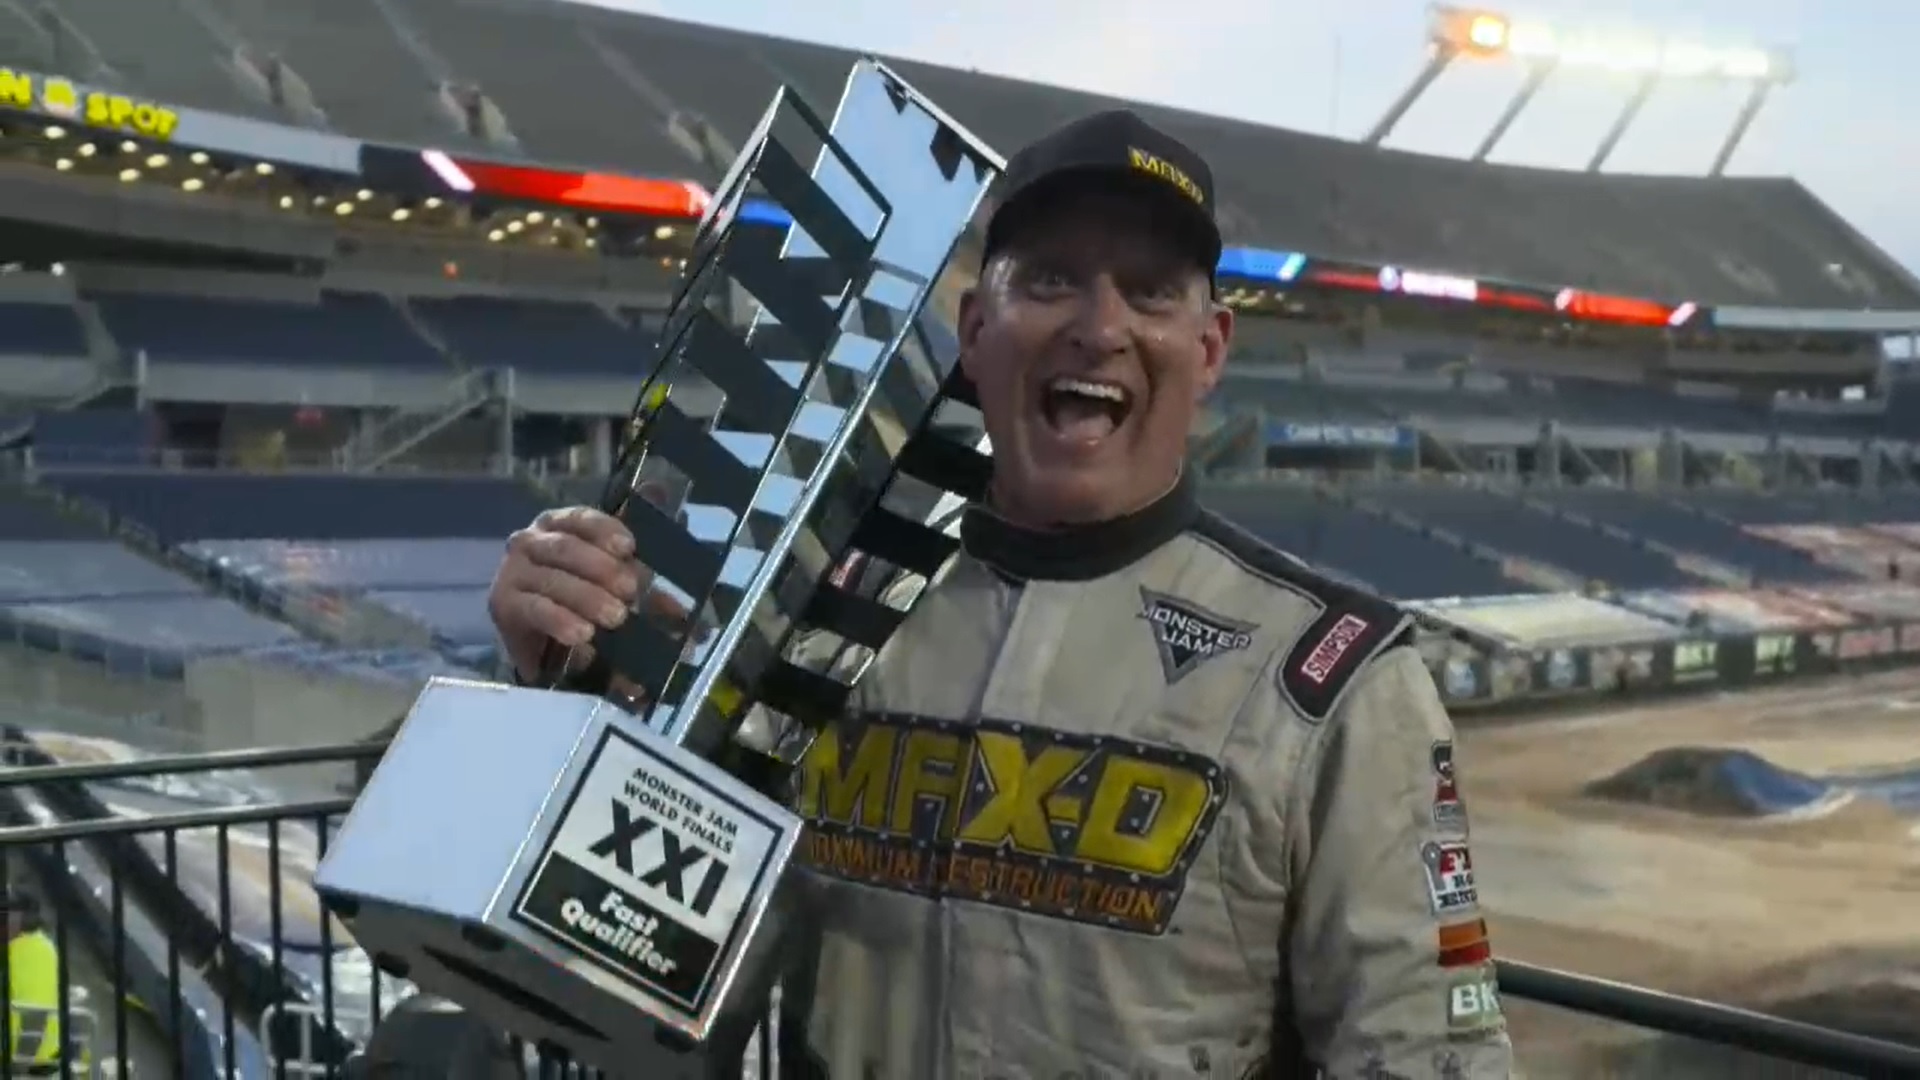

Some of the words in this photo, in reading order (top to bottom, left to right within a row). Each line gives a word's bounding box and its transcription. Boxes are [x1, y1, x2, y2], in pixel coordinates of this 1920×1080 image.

[85, 91, 179, 142] SPOT
[1144, 603, 1251, 649] MONSTER
[1162, 631, 1213, 655] JAM
[1305, 614, 1364, 679] SIMPSON
[624, 780, 678, 820] WORLD
[681, 816, 733, 854] FINALS
[632, 767, 703, 815] MONSTER
[705, 810, 738, 837] JAM
[588, 798, 729, 918] XXI
[561, 898, 677, 976] Qualifier
[600, 890, 659, 936] Fast
